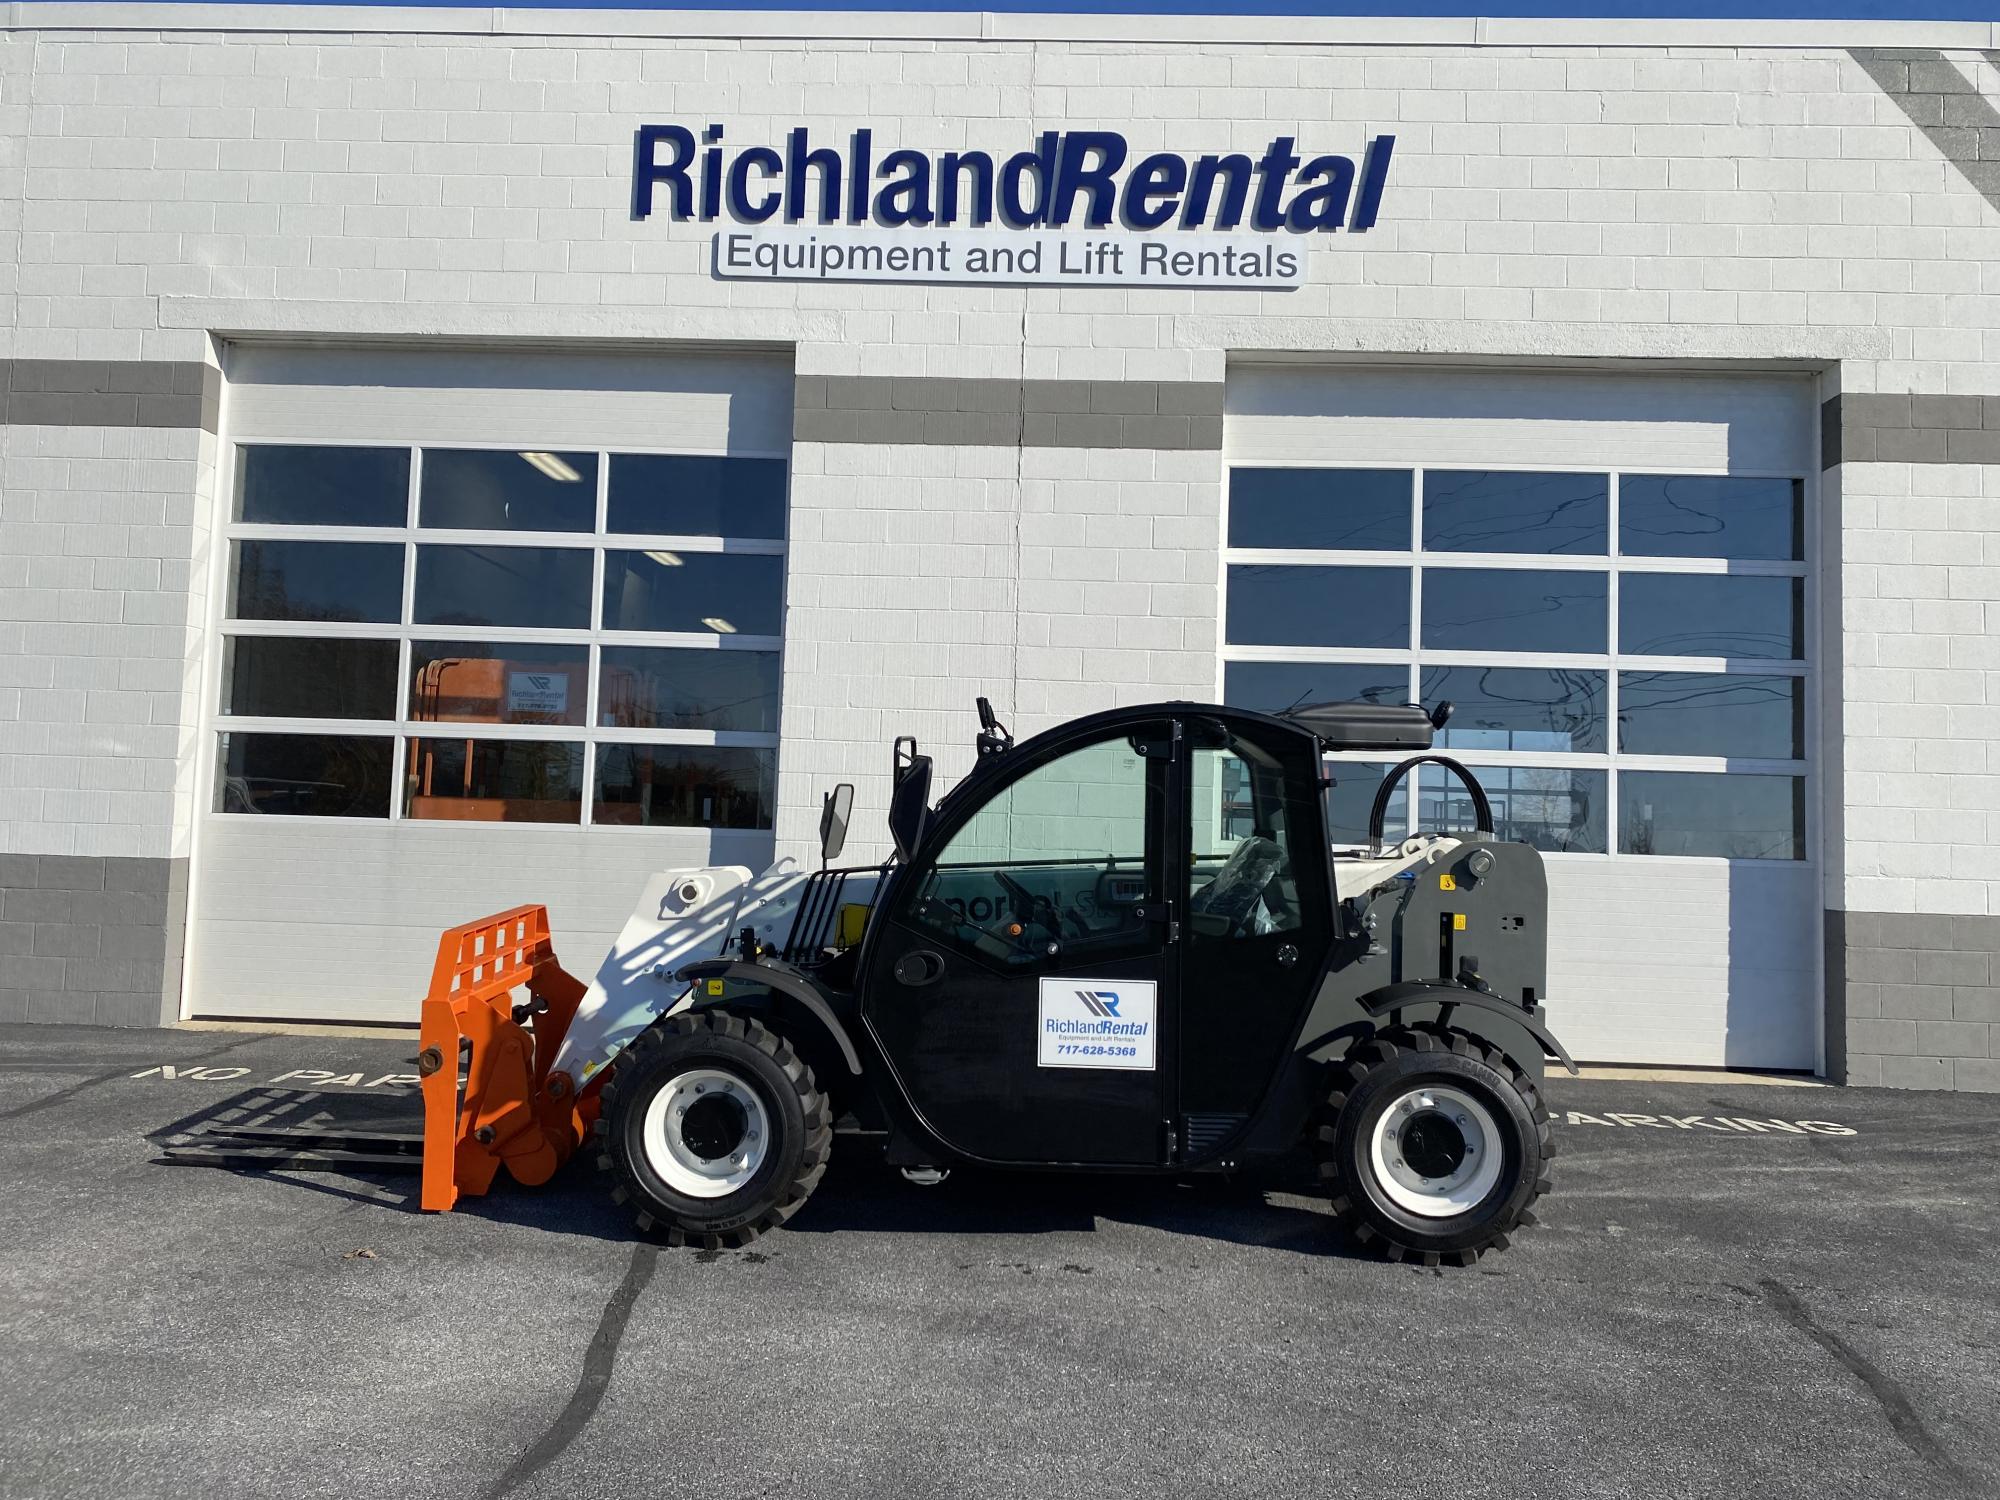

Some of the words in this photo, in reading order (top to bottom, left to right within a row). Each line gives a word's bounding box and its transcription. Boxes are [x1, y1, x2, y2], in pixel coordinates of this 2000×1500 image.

[634, 124, 1397, 229] RichlandRental
[726, 234, 951, 277] Equipment
[965, 241, 1042, 274] and
[1059, 240, 1124, 276] Lift
[1140, 242, 1298, 278] Rentals
[1046, 1018, 1148, 1036] RichlandRental
[1058, 1034, 1089, 1042] Equipment
[1057, 1045, 1137, 1057] 717-628-5368
[130, 1065, 252, 1081] NO
[1550, 1110, 1858, 1137] ARKING
